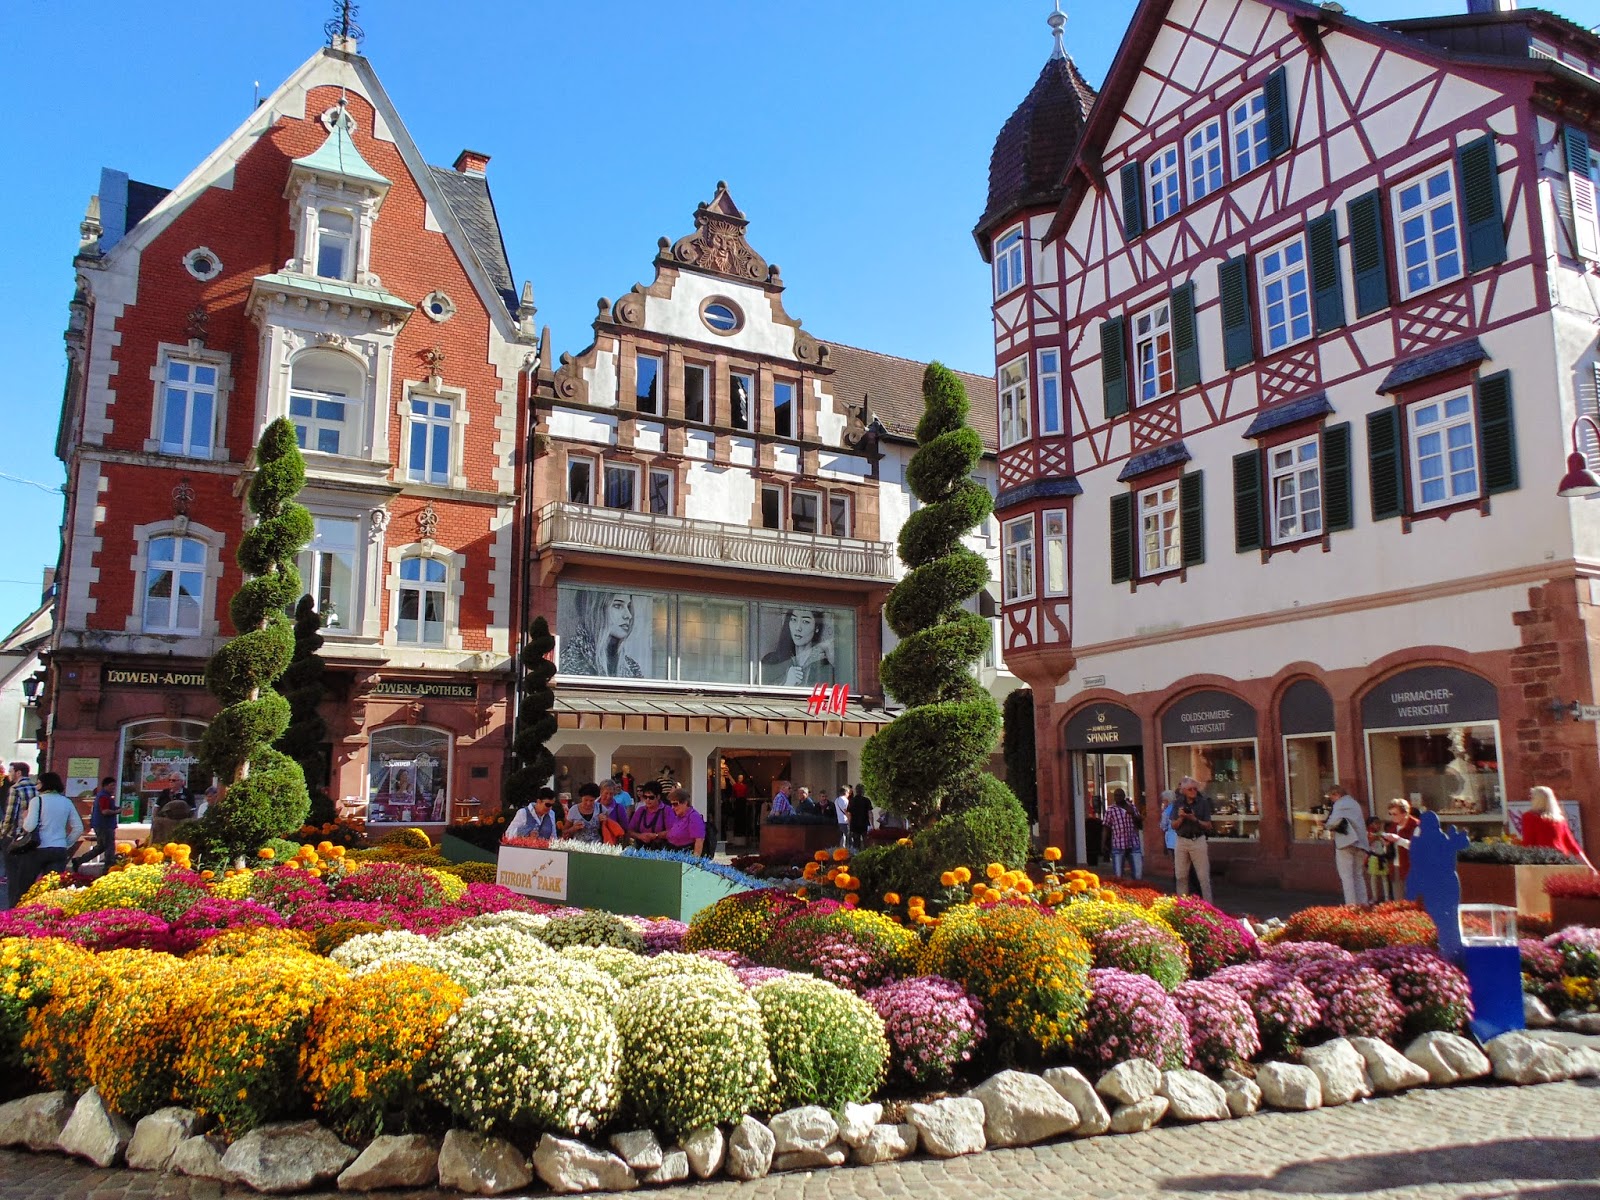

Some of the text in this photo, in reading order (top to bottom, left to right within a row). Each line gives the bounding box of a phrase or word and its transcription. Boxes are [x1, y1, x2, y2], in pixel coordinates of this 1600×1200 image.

[108, 670, 206, 685] LÖWEN-APOTH
[807, 683, 849, 717] H&M
[1391, 688, 1453, 704] UHRMACHER-
[1181, 709, 1233, 722] GOLDSCHMIEDE-
[1398, 703, 1449, 717] WERKSTATT
[1190, 722, 1226, 734] WERKSTATT
[1086, 731, 1119, 744] SPINNER
[500, 870, 562, 893] EUROPA PARK
